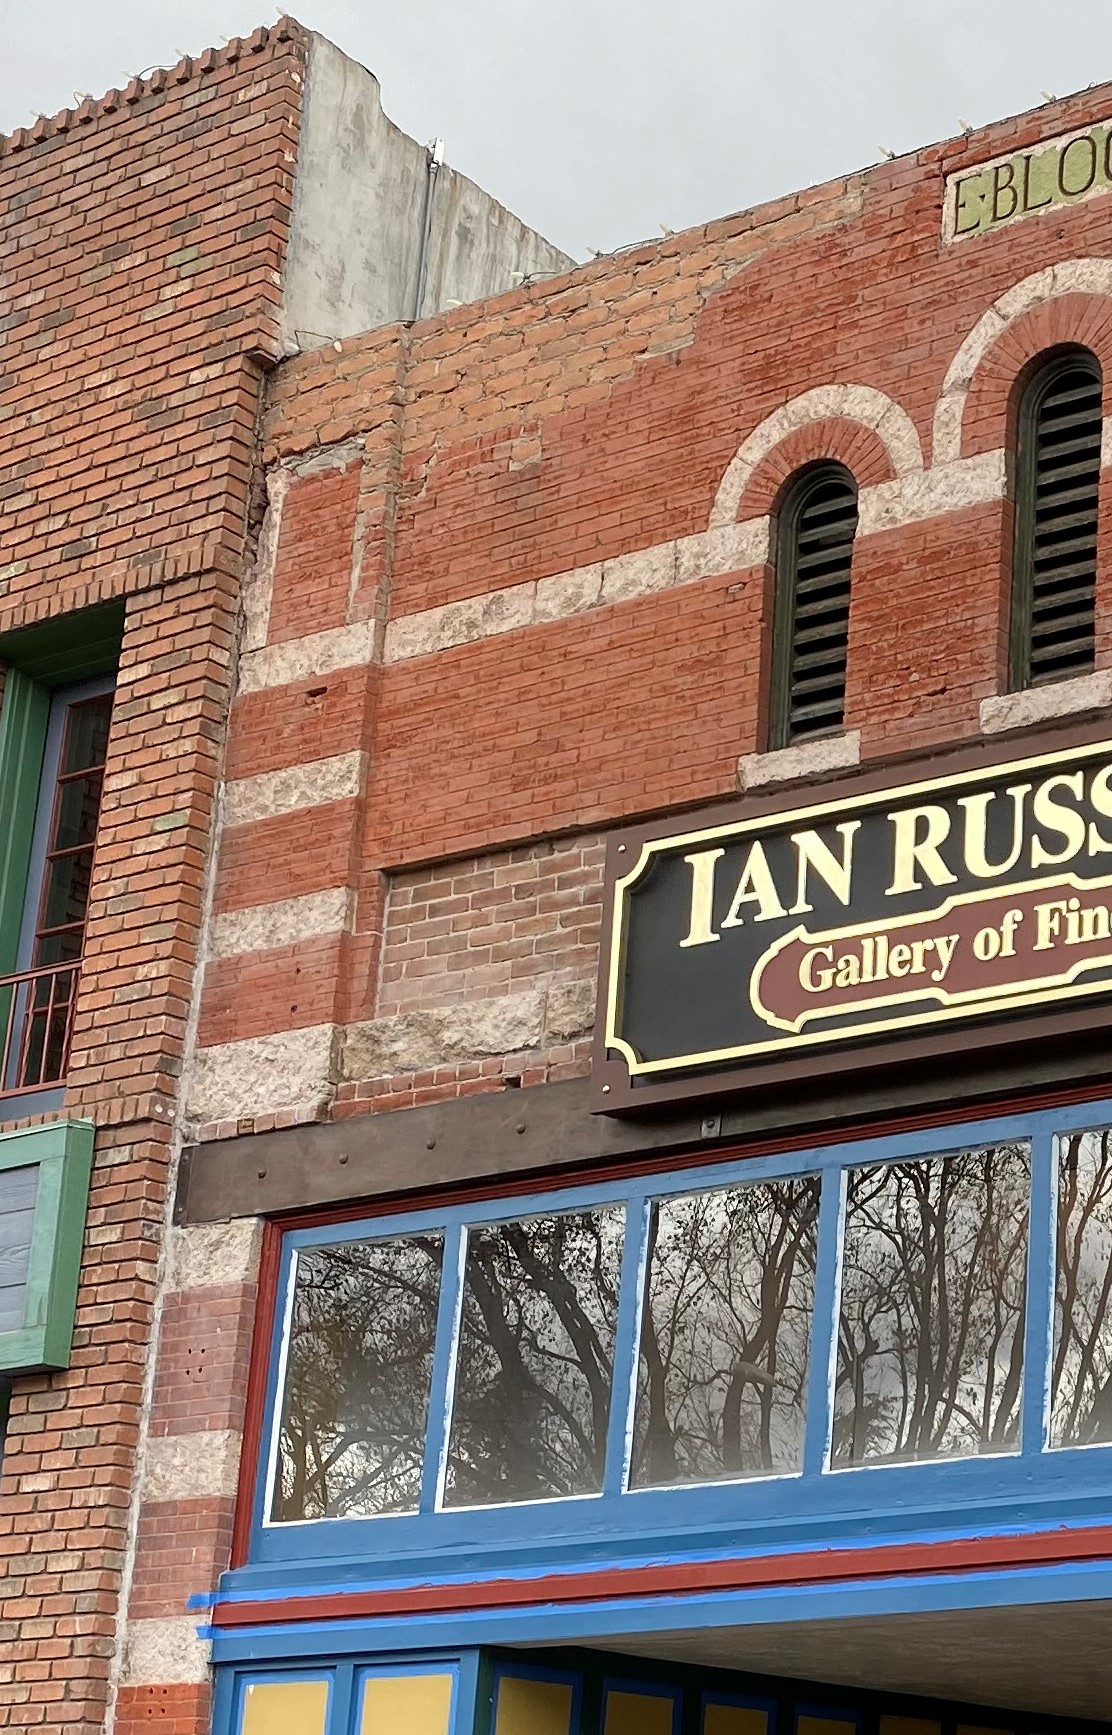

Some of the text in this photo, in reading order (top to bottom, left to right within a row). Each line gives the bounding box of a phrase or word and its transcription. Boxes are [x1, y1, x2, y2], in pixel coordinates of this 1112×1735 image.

[680, 820, 861, 948] IAN
[798, 933, 960, 994] Gallery
[972, 907, 1024, 961] of
